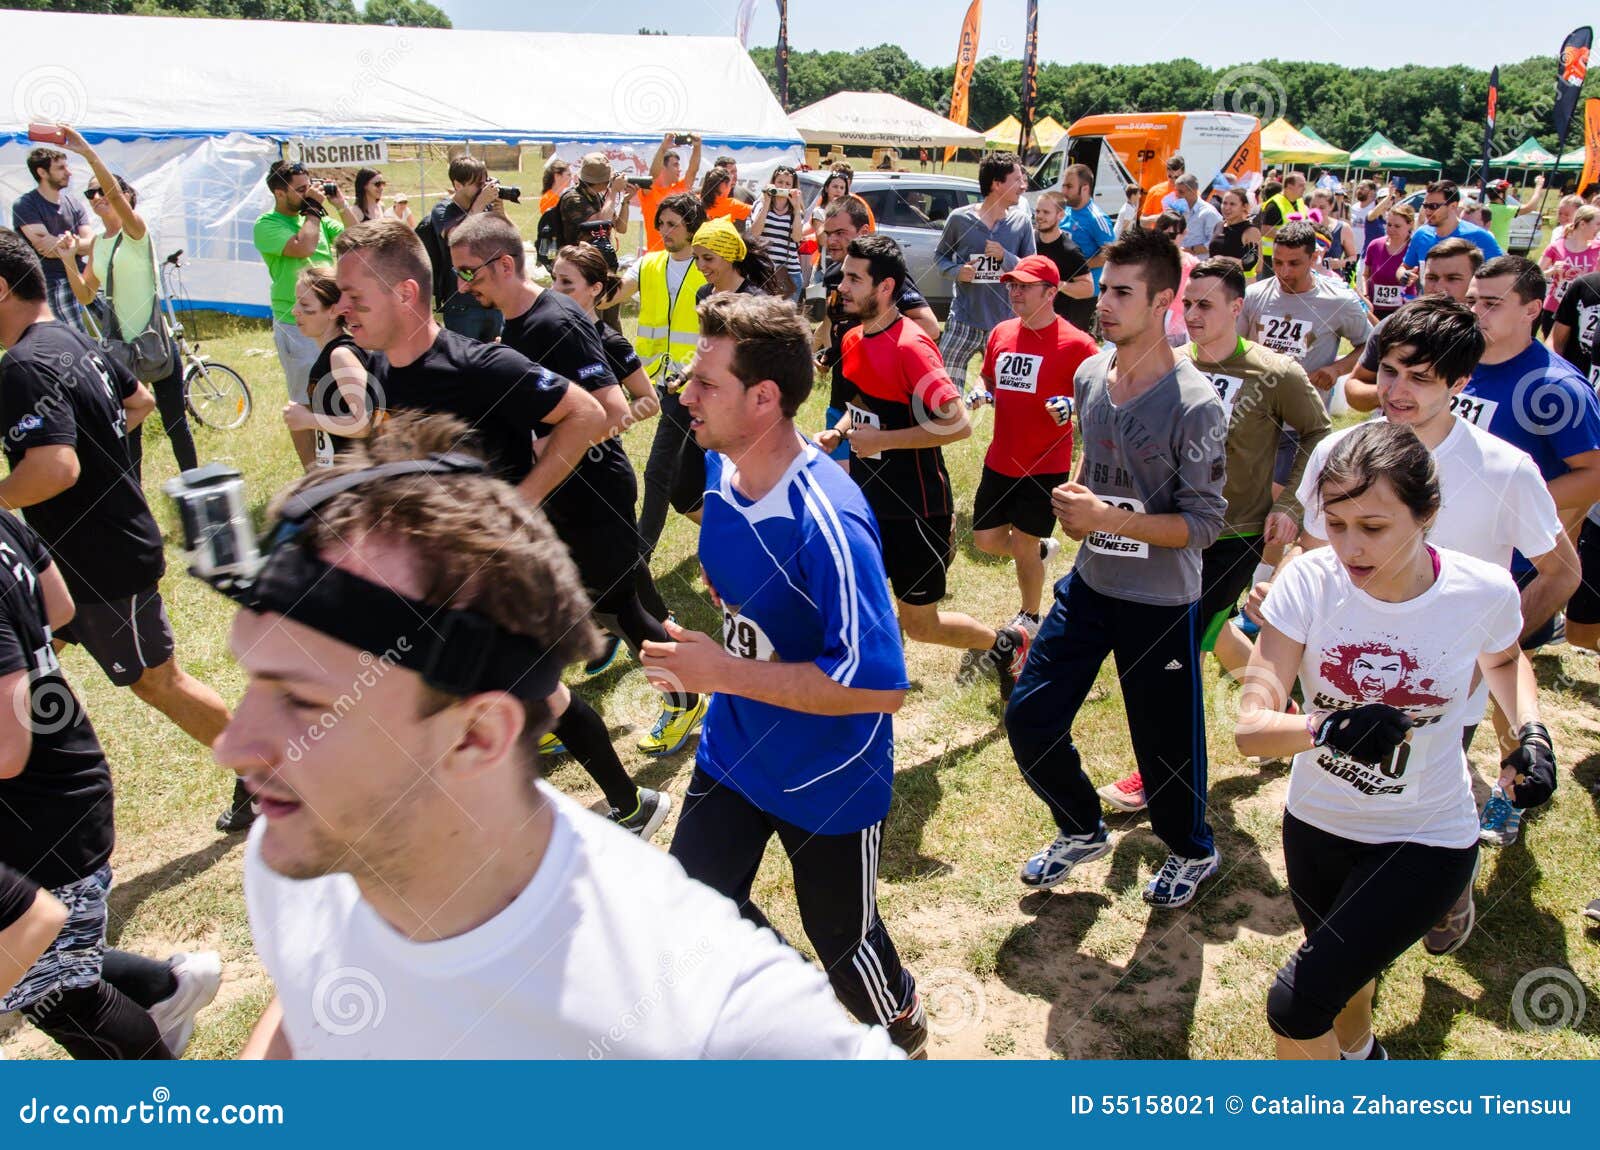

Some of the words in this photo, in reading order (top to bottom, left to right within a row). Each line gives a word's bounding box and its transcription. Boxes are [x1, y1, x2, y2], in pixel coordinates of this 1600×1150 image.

[298, 142, 381, 163] ÎNSCRIERI
[1561, 255, 1593, 269] ALL
[1377, 286, 1398, 298] 439
[1266, 318, 1303, 342] 224
[1000, 355, 1034, 377] 205
[1316, 757, 1408, 796] MUDNESS
[1319, 753, 1386, 785] ULTIMATE
